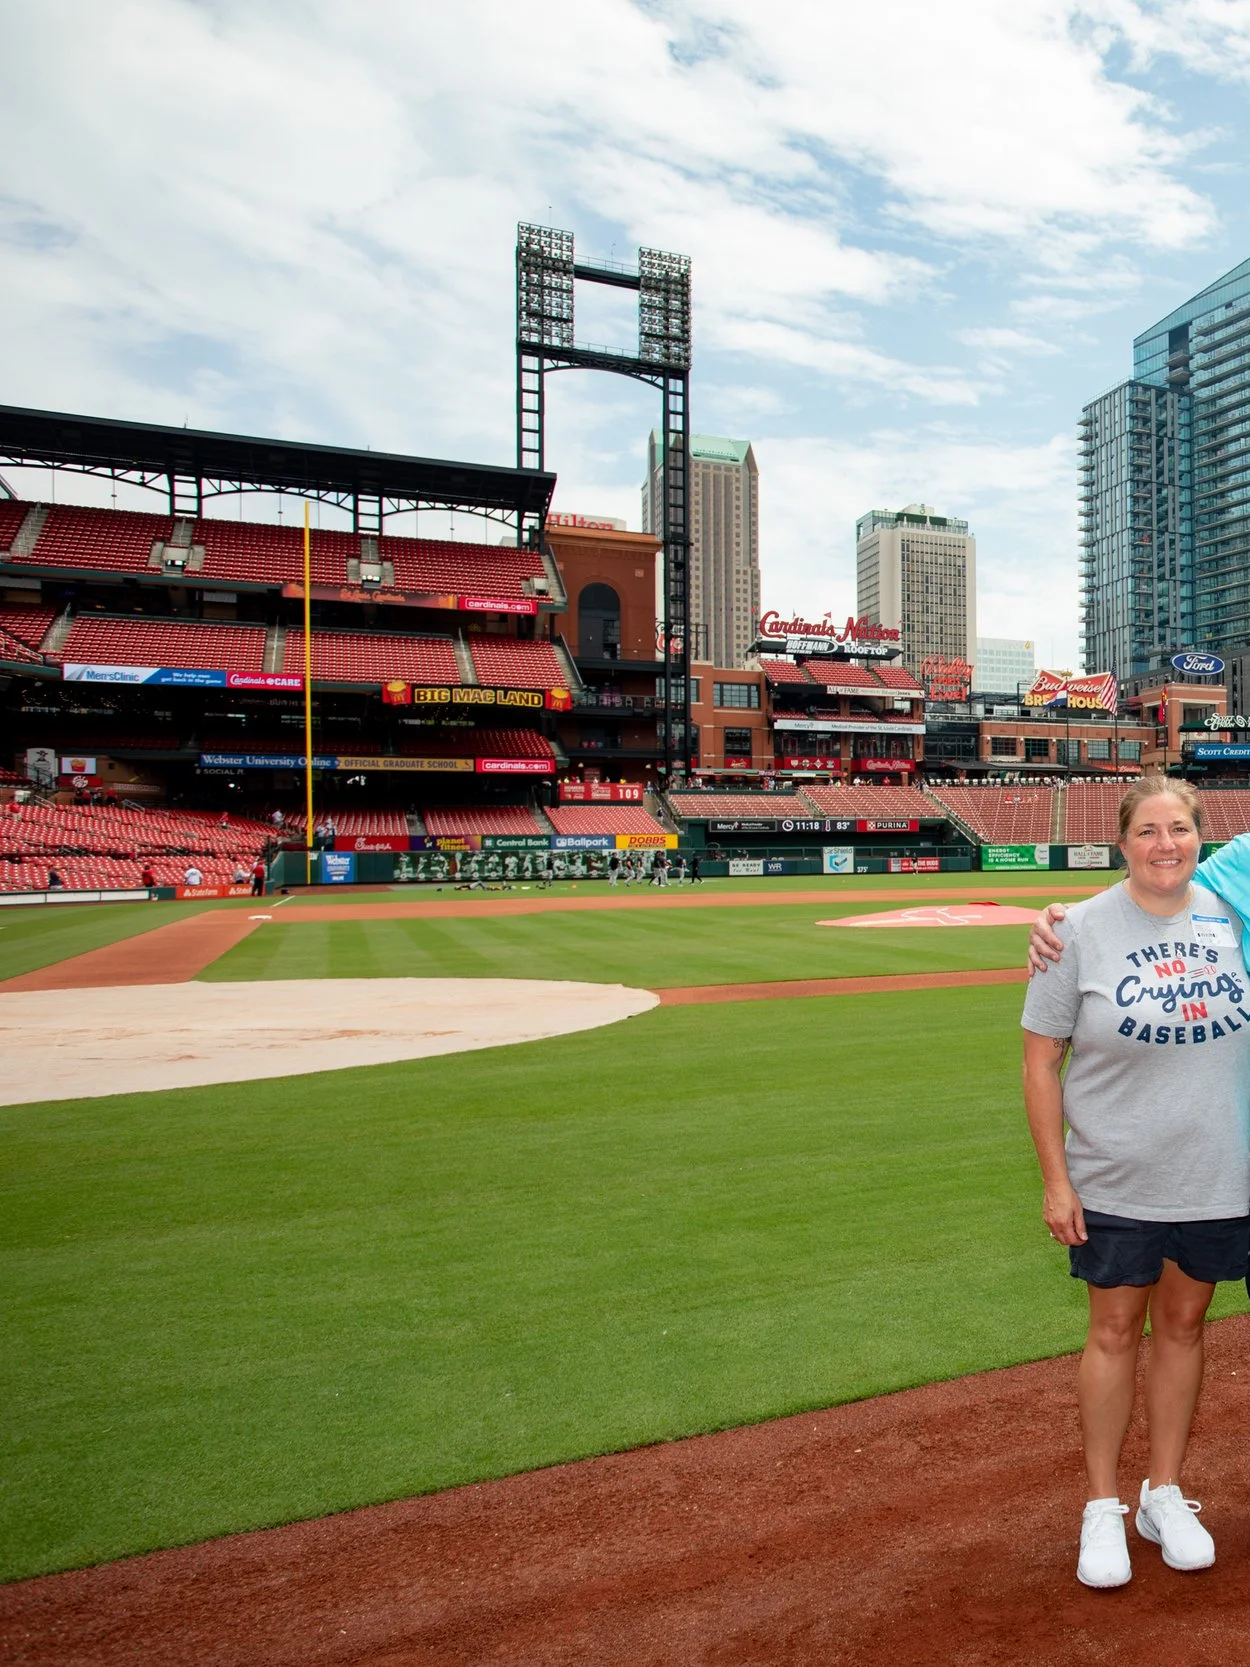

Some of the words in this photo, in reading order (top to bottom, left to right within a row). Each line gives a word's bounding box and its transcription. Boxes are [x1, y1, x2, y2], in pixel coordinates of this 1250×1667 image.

[548, 513, 614, 530] Hilton
[468, 601, 530, 610] cardinals.com
[760, 611, 837, 639] Cardinals
[836, 616, 900, 642] Nation
[787, 640, 830, 652] HOFFMANN
[843, 645, 888, 656] ROOFTOP
[1183, 654, 1215, 672] Ford
[230, 674, 265, 686] Cardinals
[274, 678, 301, 687] CARE
[415, 688, 451, 703] BIG
[452, 689, 495, 704] MAC
[497, 691, 543, 707] LAND
[1198, 747, 1222, 756] SCOTT
[1223, 747, 1250, 756] CREDIT
[203, 755, 243, 766] Webster
[246, 756, 296, 768] University
[303, 757, 331, 767] Online
[344, 759, 380, 768] OFFICIAL
[384, 760, 424, 768] GRADUATE
[428, 760, 458, 769] SCHOOL
[485, 762, 547, 770] cardinals.com
[619, 789, 639, 799] 109
[717, 823, 735, 832] Mercy
[796, 822, 820, 830] 11:18
[837, 822, 851, 830] 83°
[877, 822, 907, 830] PURINA
[437, 838, 465, 846] planet
[497, 838, 526, 847] Central
[529, 837, 550, 846] Bank
[567, 836, 609, 848] Ballpark
[630, 836, 666, 844] DOBBS
[326, 855, 350, 865] Webster
[192, 888, 218, 897] StateFarm
[1126, 942, 1219, 968] THERE'S
[1154, 959, 1187, 978] NO
[1116, 972, 1244, 1013] Crying
[1181, 1001, 1208, 1021] IN
